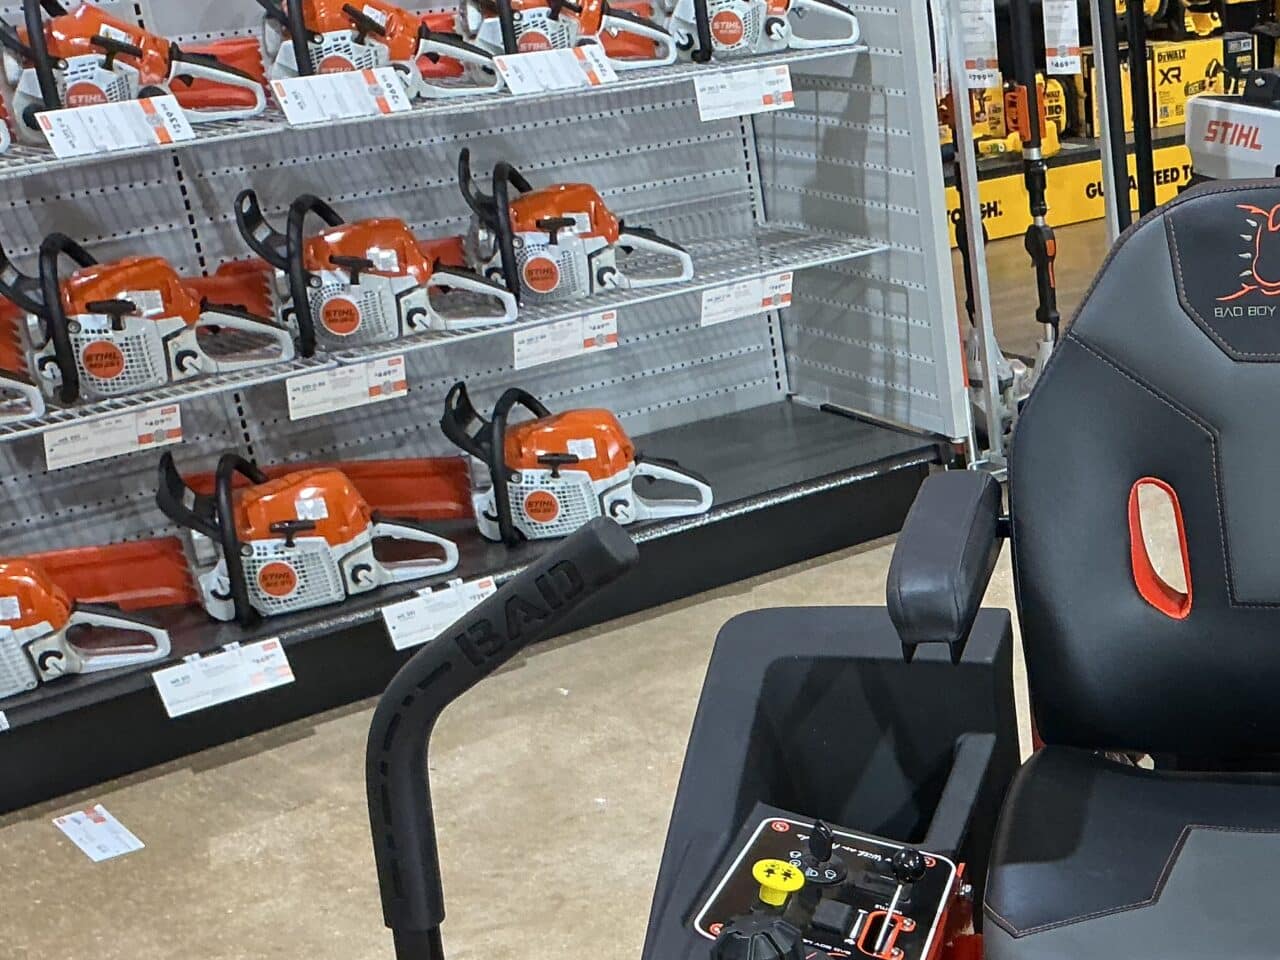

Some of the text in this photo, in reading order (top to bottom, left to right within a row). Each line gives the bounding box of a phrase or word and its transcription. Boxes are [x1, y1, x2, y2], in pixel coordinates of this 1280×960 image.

[713, 21, 740, 30] STIHL
[1158, 66, 1182, 86] XR
[69, 94, 106, 104] STIHL
[1204, 120, 1263, 150] STIHL
[324, 309, 354, 318] STIHL
[1214, 306, 1243, 318] BAD
[1248, 306, 1276, 317] BOY
[86, 352, 119, 362] STIHL
[262, 572, 290, 581] STIHL
[455, 560, 584, 666] BAD
